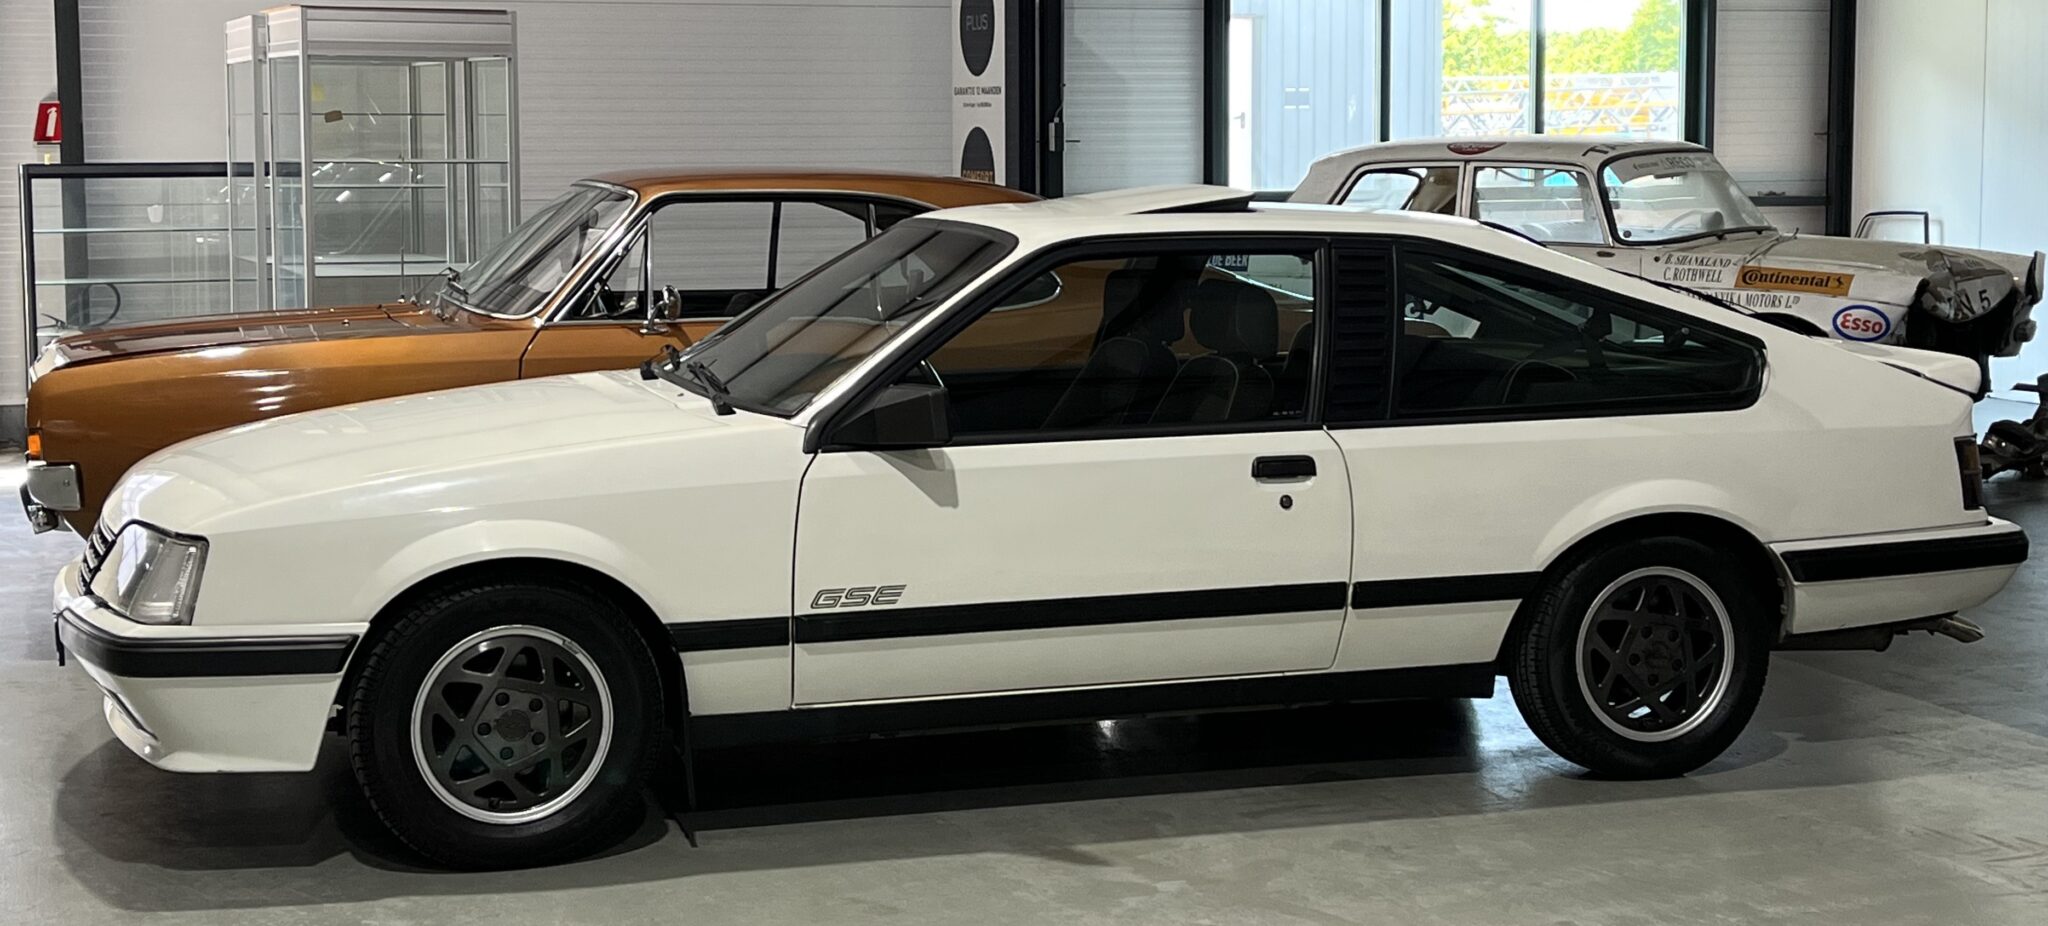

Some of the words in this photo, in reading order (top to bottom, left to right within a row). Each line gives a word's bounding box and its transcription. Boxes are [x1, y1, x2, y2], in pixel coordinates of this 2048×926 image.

[966, 13, 989, 31] PLUS
[1665, 253, 1673, 265] B.
[1675, 255, 1732, 268] SHANKLAND
[1672, 267, 1723, 283] ROTHWELL
[1742, 269, 1831, 288] Continental
[1745, 293, 1782, 308] MOTORS
[810, 585, 907, 609] GSE
